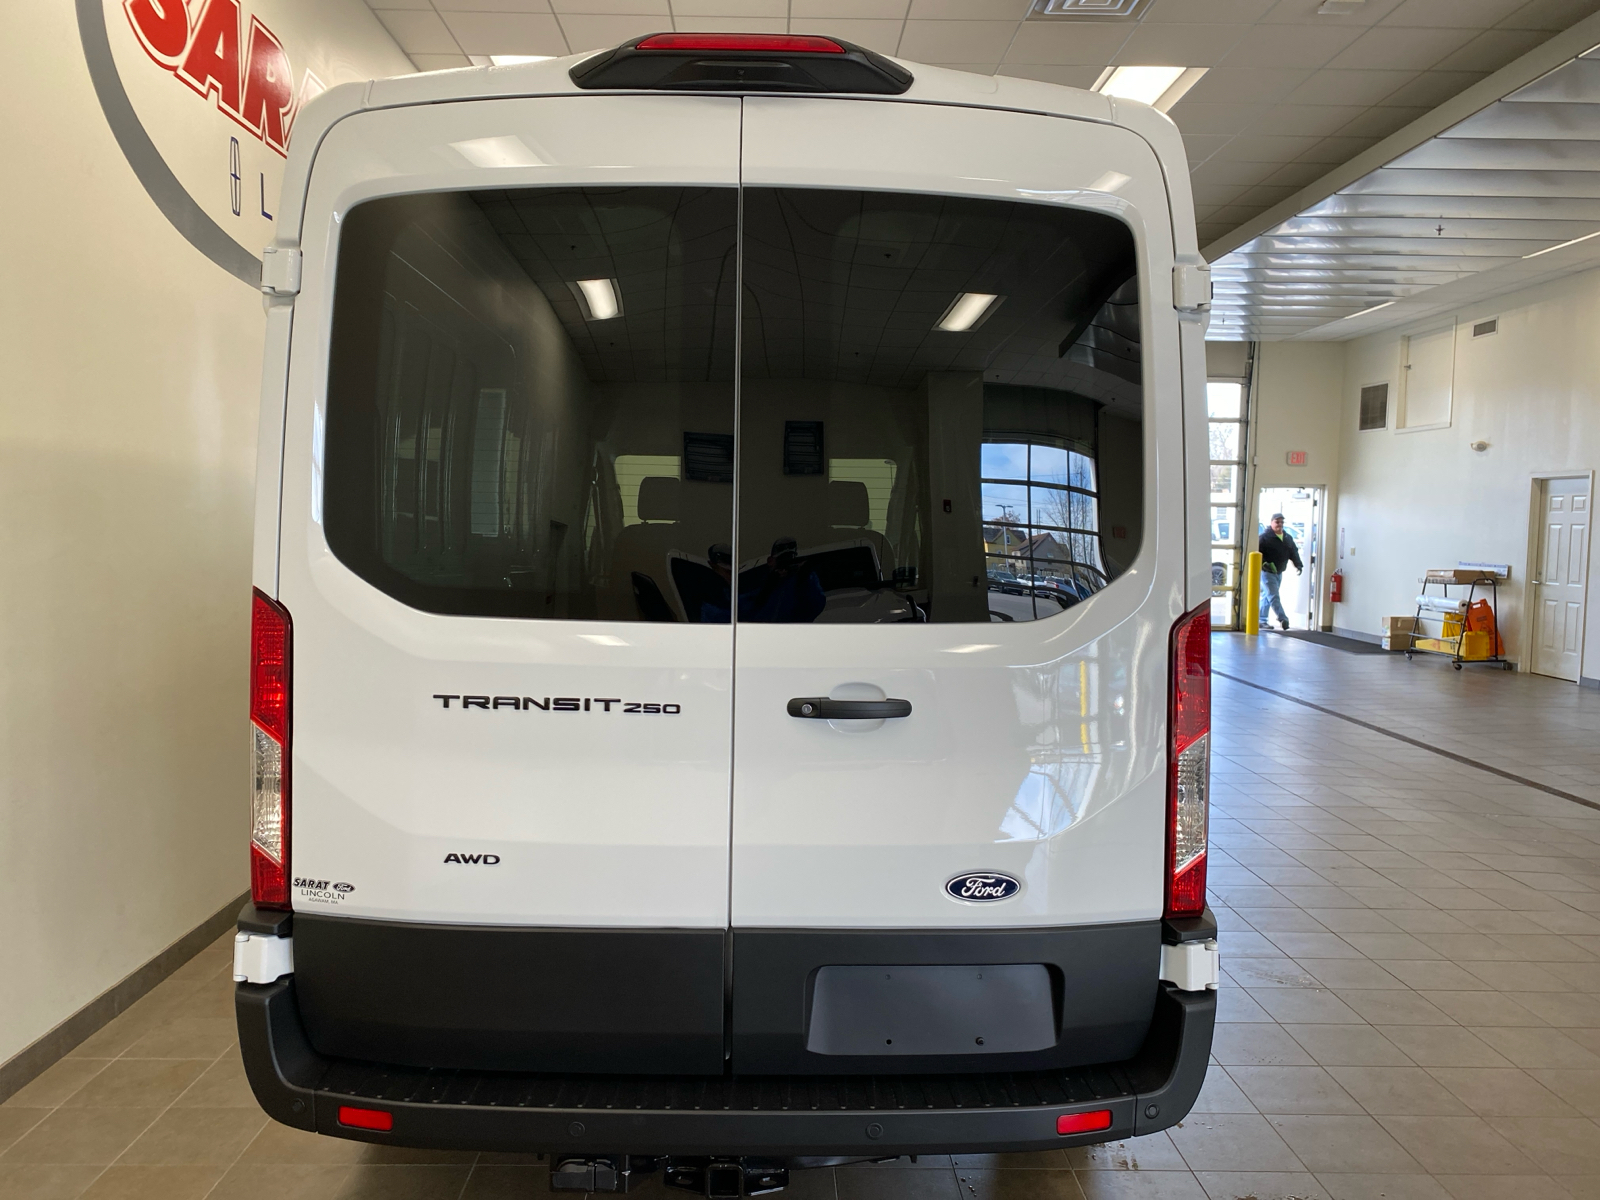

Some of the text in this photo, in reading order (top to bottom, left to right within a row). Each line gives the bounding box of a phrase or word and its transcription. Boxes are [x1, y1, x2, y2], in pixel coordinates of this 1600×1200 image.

[1290, 451, 1306, 464] EXIT
[433, 694, 681, 714] TRANSIT 250
[443, 853, 501, 865] AWD
[293, 877, 330, 890] SARAT
[961, 877, 1007, 897] Ford
[301, 889, 345, 900] LINCOLN
